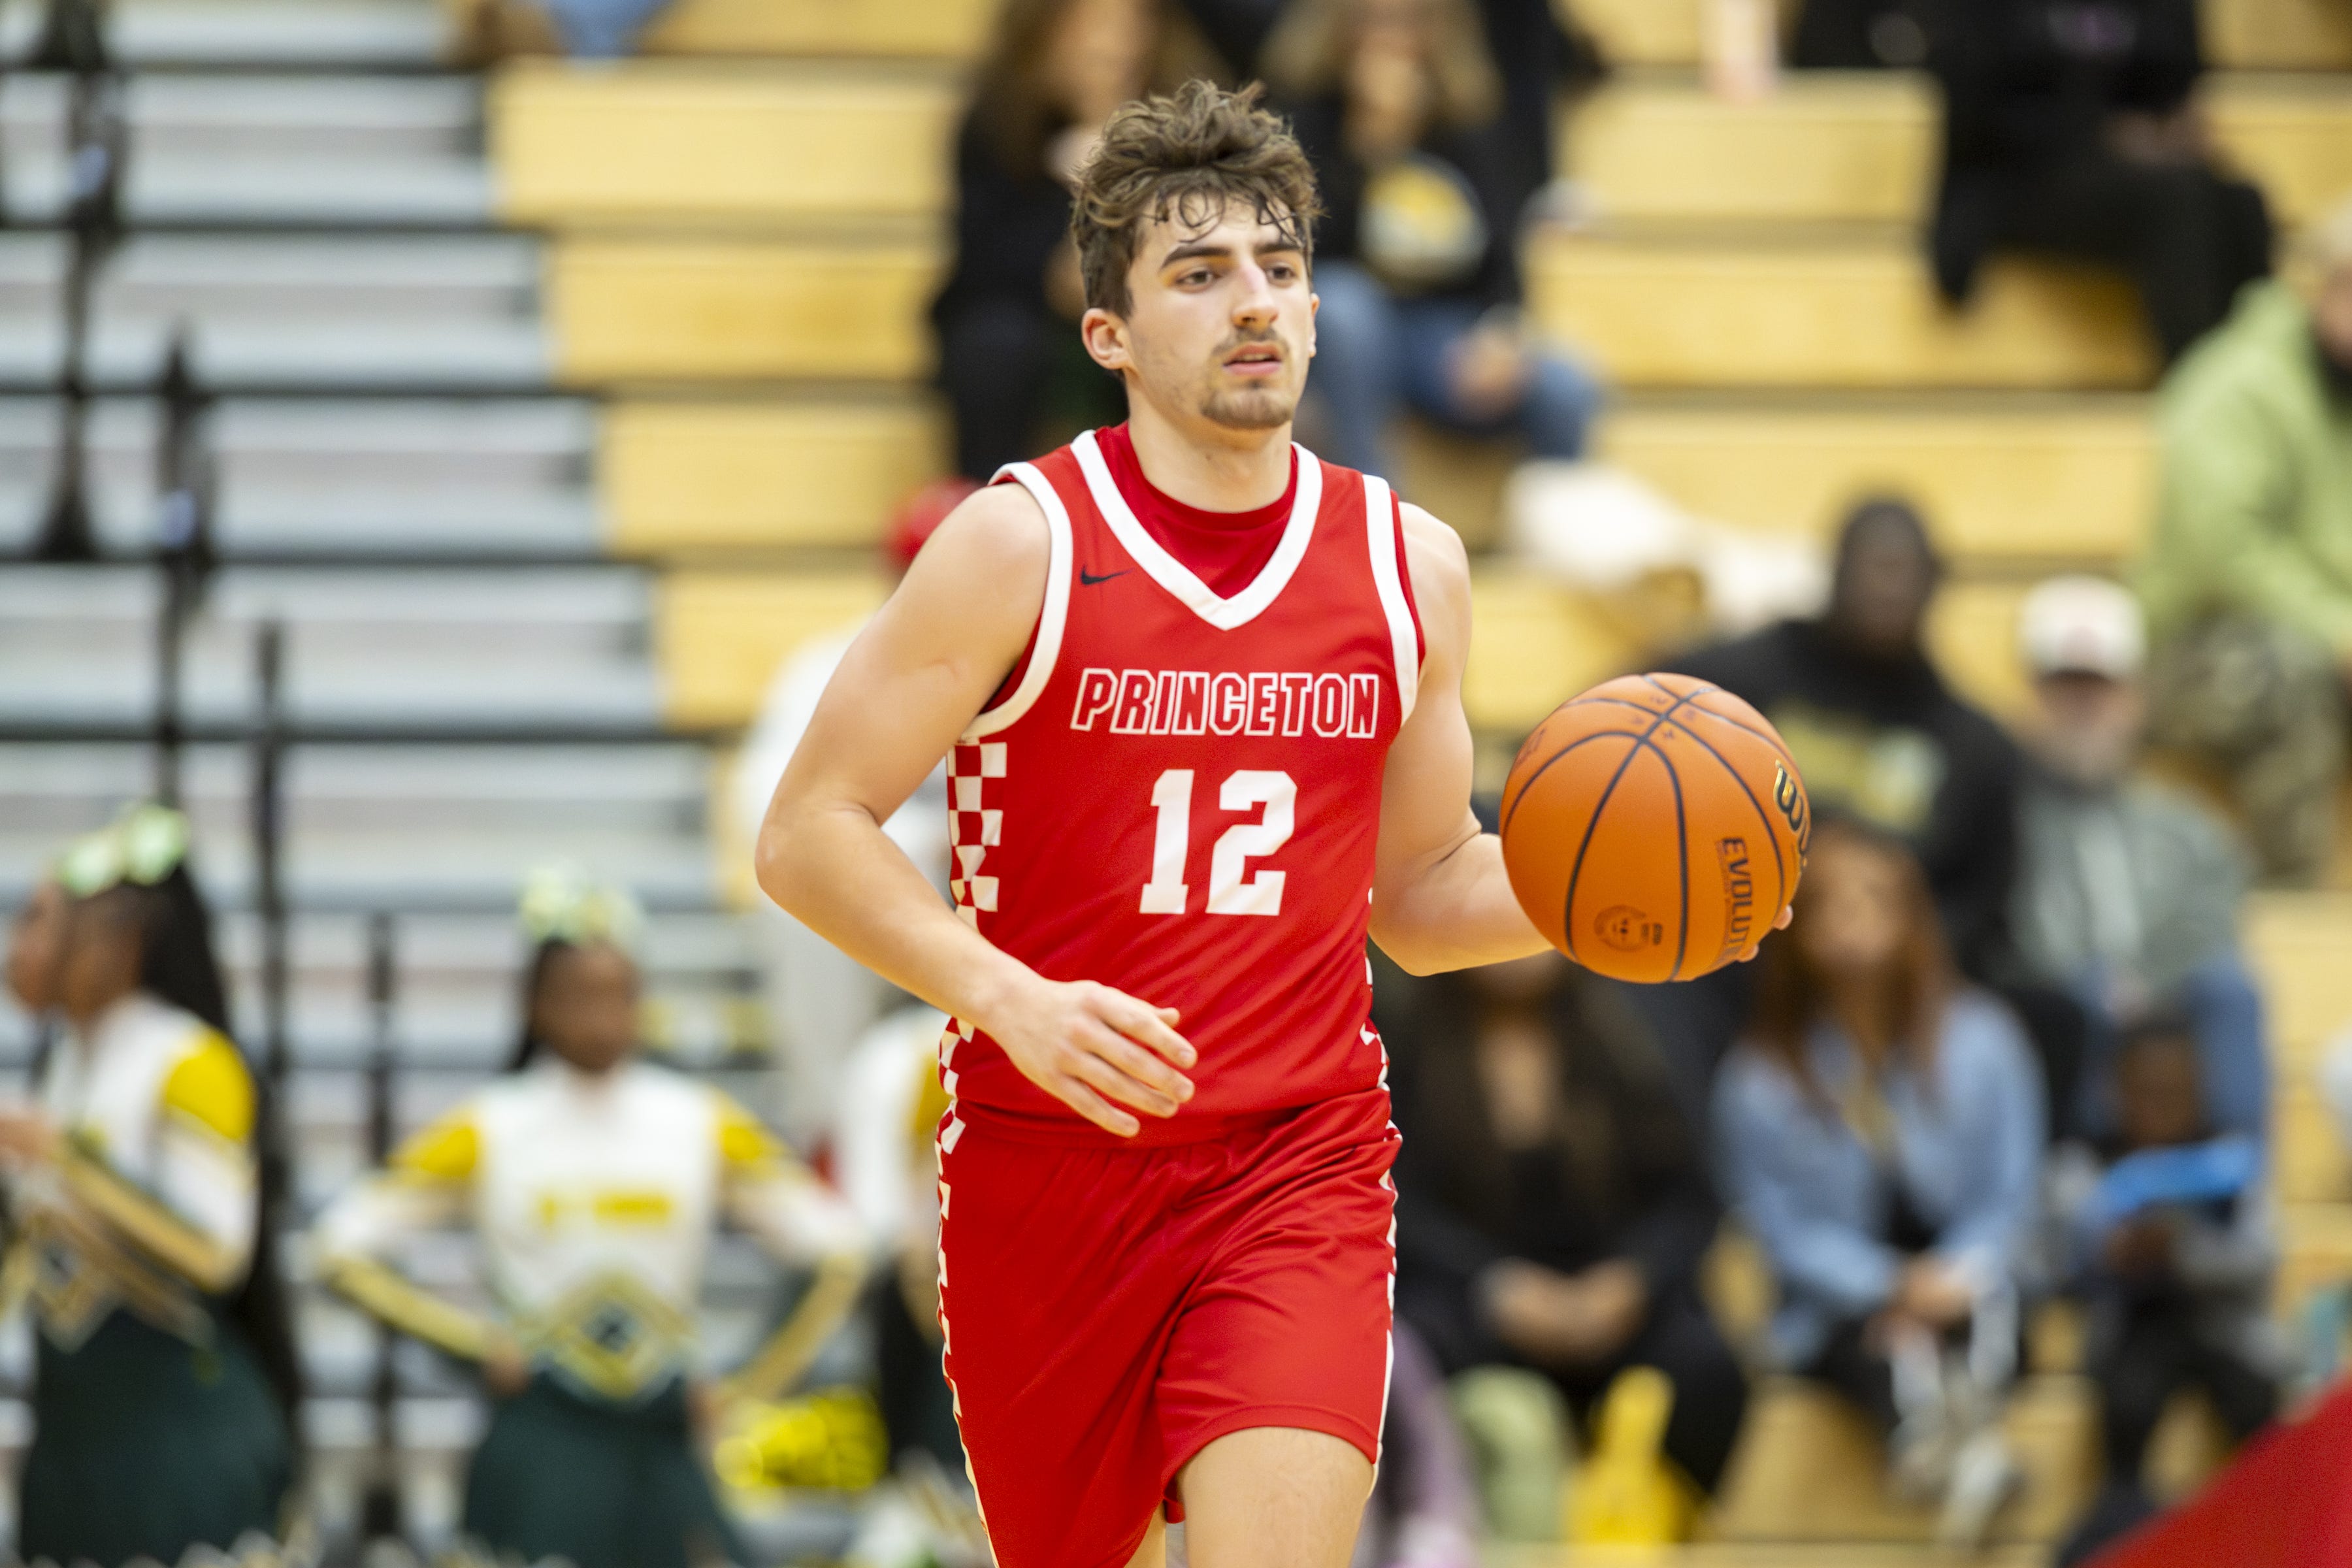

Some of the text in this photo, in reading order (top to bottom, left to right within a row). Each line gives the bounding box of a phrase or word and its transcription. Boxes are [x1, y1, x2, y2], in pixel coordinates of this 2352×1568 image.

[1070, 668, 1379, 738] PRINCETON
[1139, 769, 1298, 915] 12
[1722, 837, 1753, 956] EVOLUT
